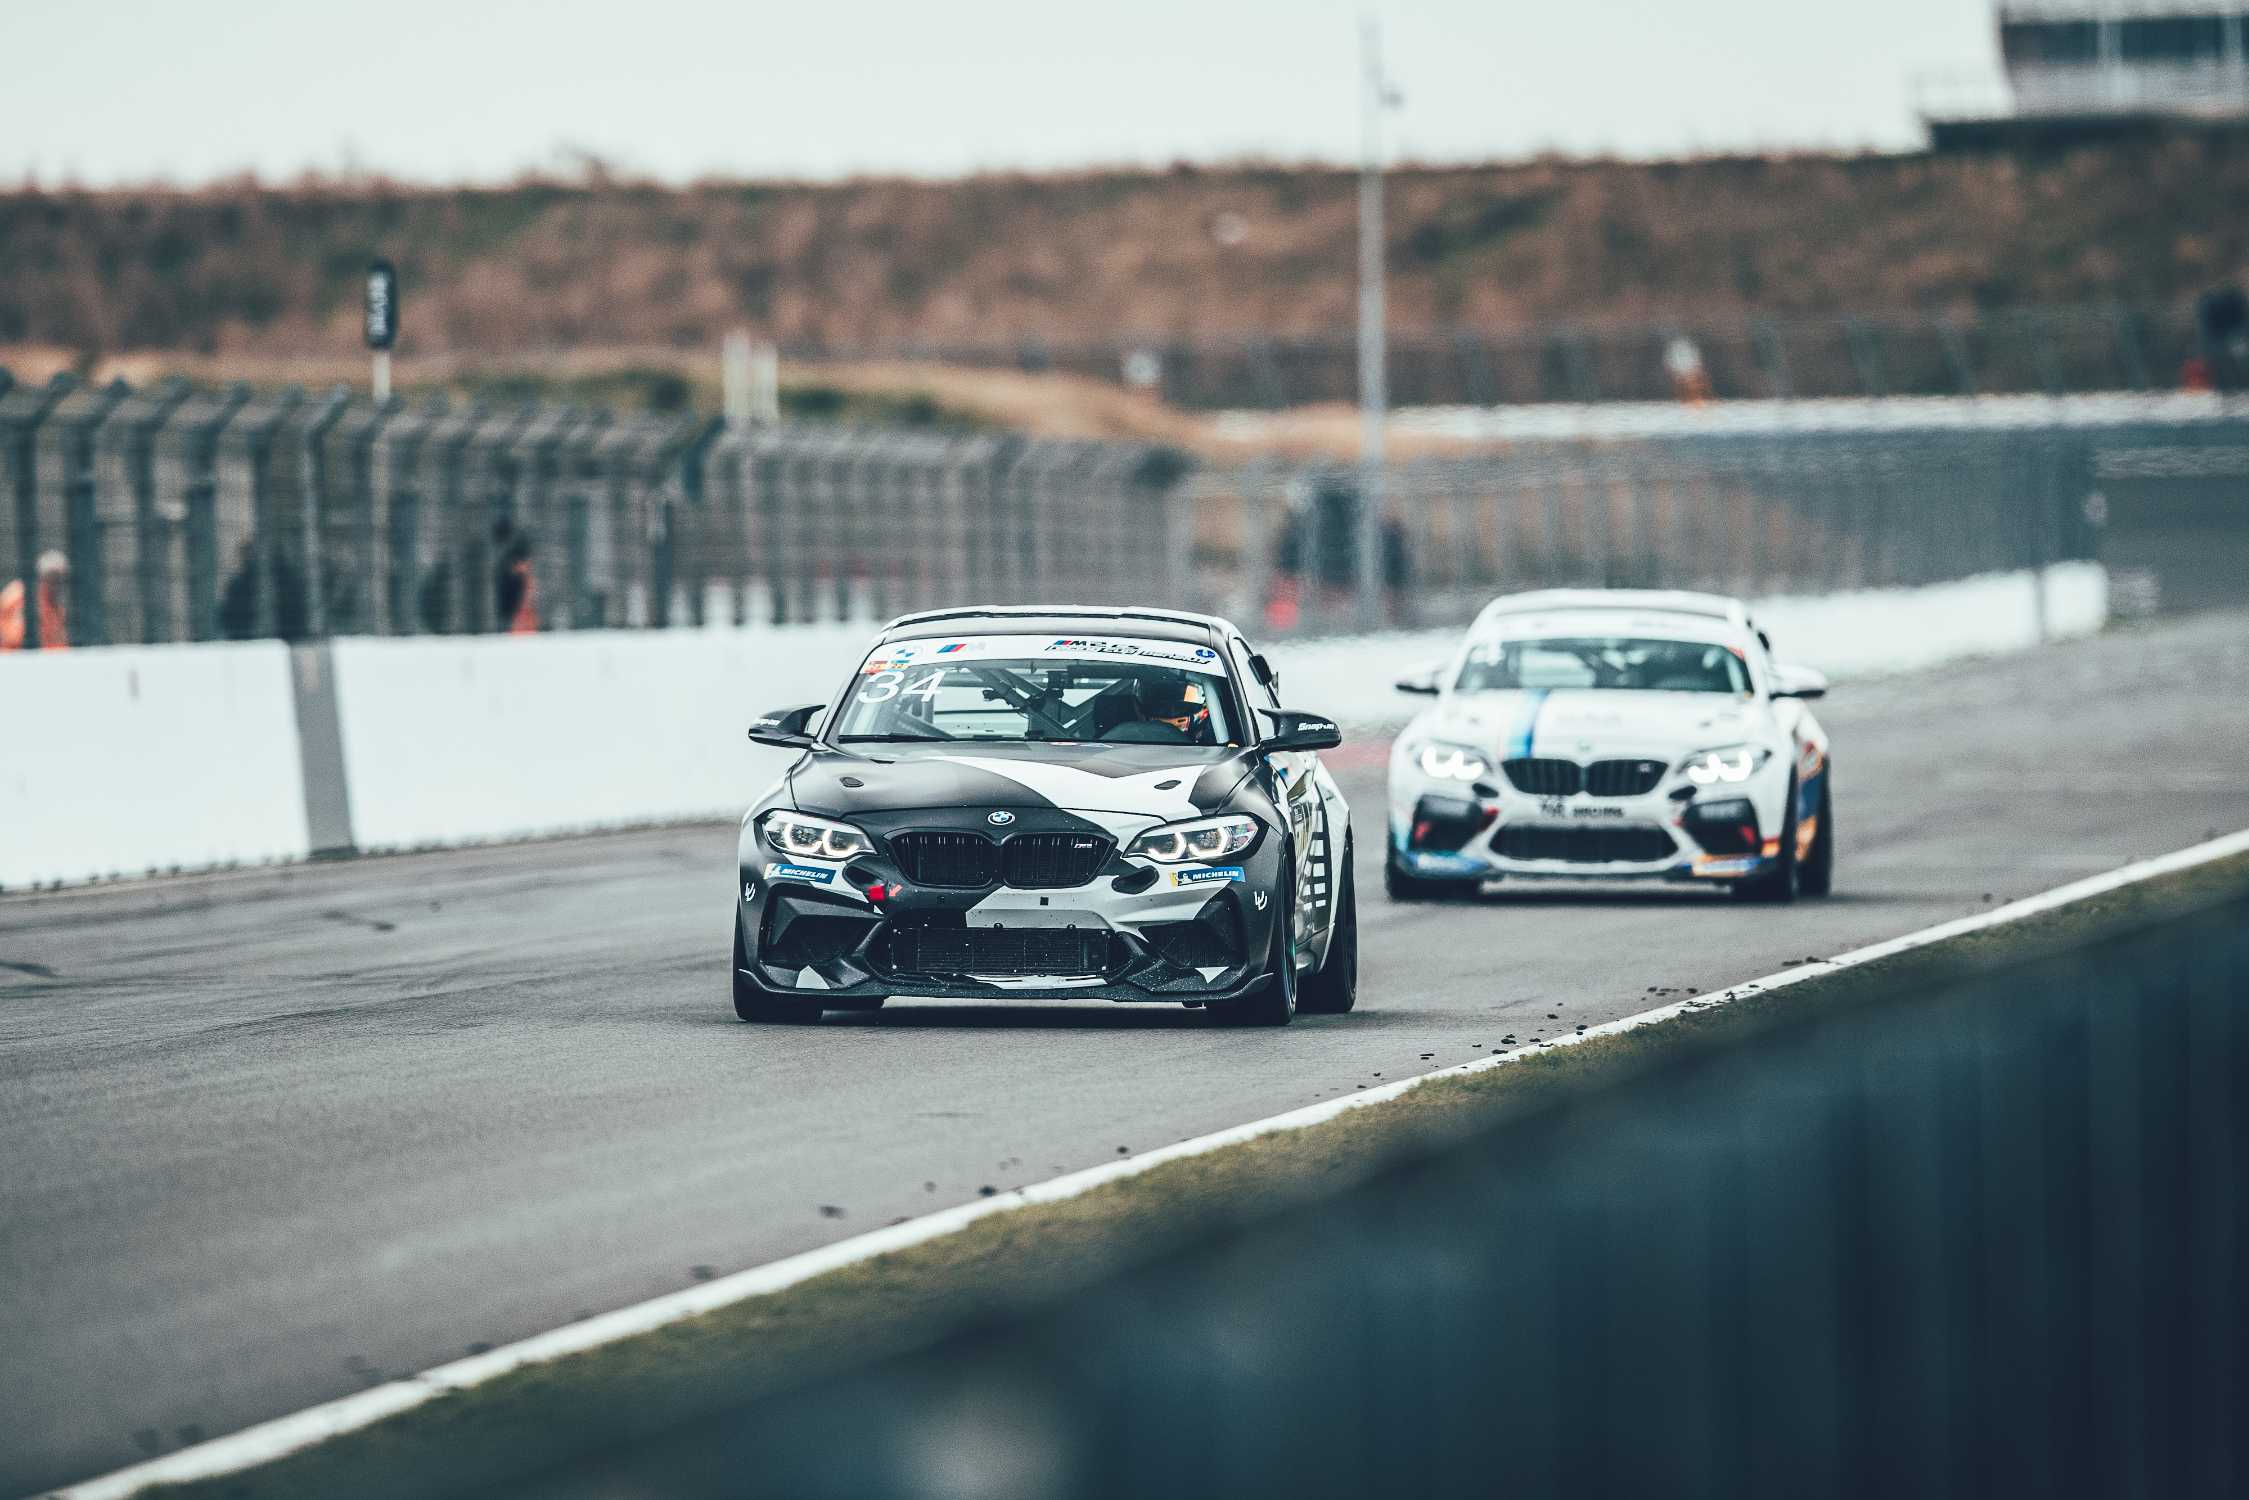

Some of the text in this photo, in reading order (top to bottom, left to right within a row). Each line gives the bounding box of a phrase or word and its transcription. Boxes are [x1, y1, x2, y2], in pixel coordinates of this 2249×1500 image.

[858, 669, 946, 703] 34
[781, 868, 829, 880] MICHELIN
[1192, 870, 1239, 880] MICHELIN
